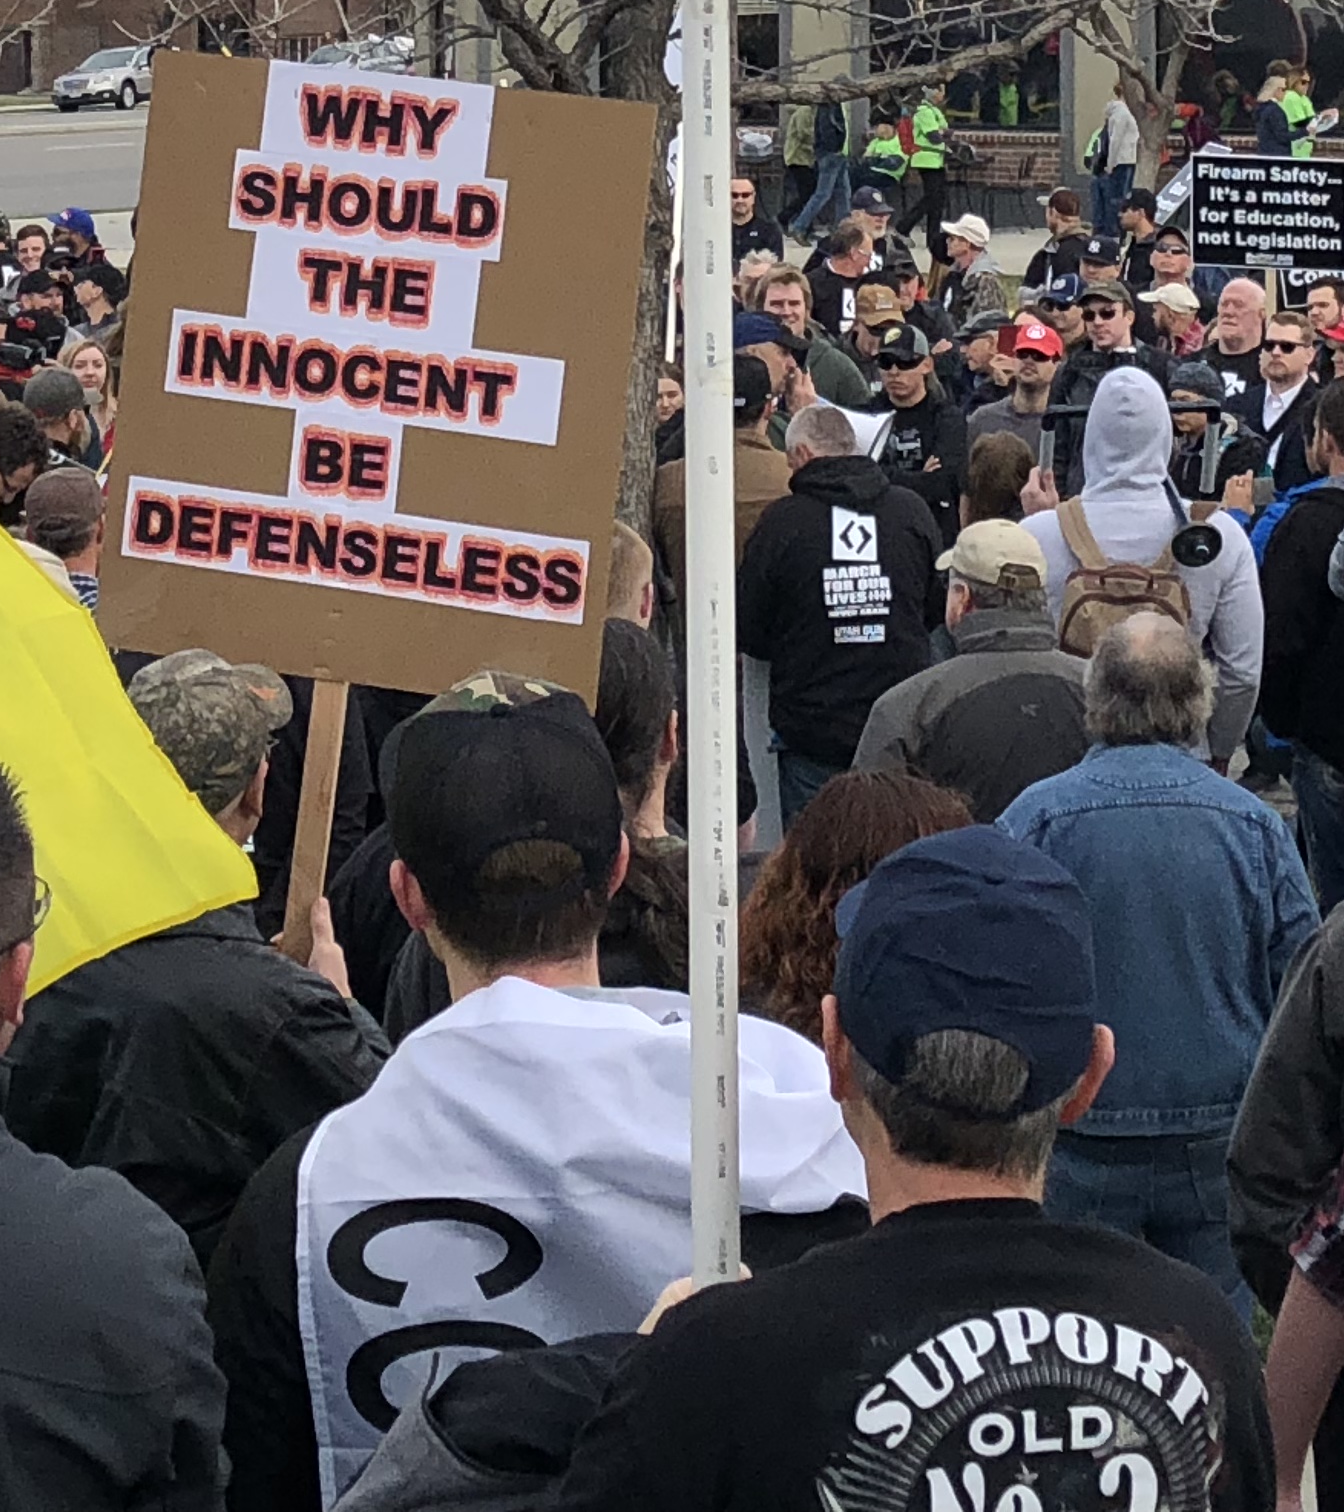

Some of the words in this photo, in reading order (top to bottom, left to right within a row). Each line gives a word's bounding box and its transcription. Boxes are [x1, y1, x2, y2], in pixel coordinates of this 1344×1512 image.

[300, 83, 461, 158] WHY
[1197, 163, 1266, 182] Firearm
[1209, 186, 1240, 203] It's
[1244, 190, 1257, 204] a
[1261, 189, 1331, 207] matter
[234, 161, 501, 249] SHOULD
[1199, 206, 1229, 224] for
[1233, 208, 1341, 232] Education,
[1197, 231, 1230, 247] not
[1235, 231, 1343, 252] Legislation
[298, 248, 437, 329] THE
[173, 322, 519, 427] INNOCENT
[298, 424, 392, 501] BE
[129, 489, 587, 612] DEFENSELESS
[822, 564, 881, 580] MARCH
[823, 579, 855, 593] FOR
[857, 577, 891, 591] OUR
[824, 590, 868, 606] LIVES
[855, 1305, 1211, 1450] SUPPORT
[968, 1404, 1115, 1458] OLD
